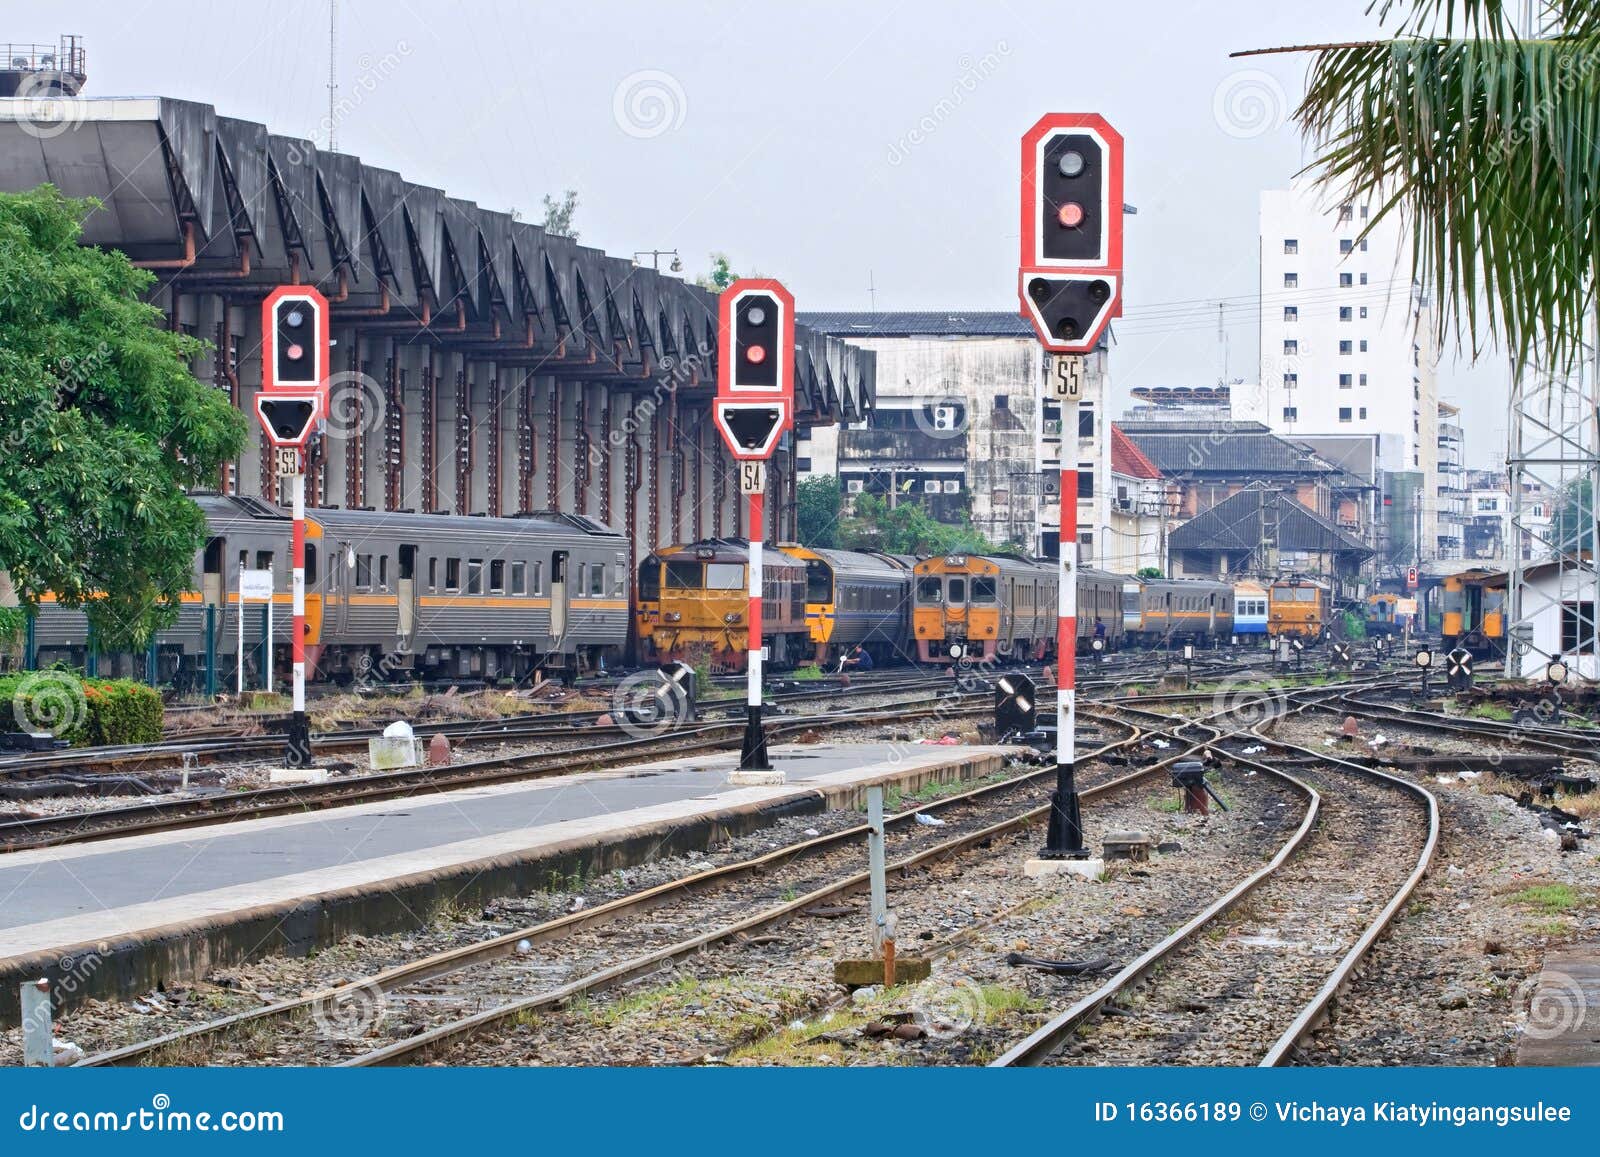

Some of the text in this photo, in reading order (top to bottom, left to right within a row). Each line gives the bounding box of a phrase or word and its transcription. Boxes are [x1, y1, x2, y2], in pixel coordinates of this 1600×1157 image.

[1057, 360, 1079, 395] S5
[281, 451, 296, 474] S3
[744, 464, 760, 490] S4
